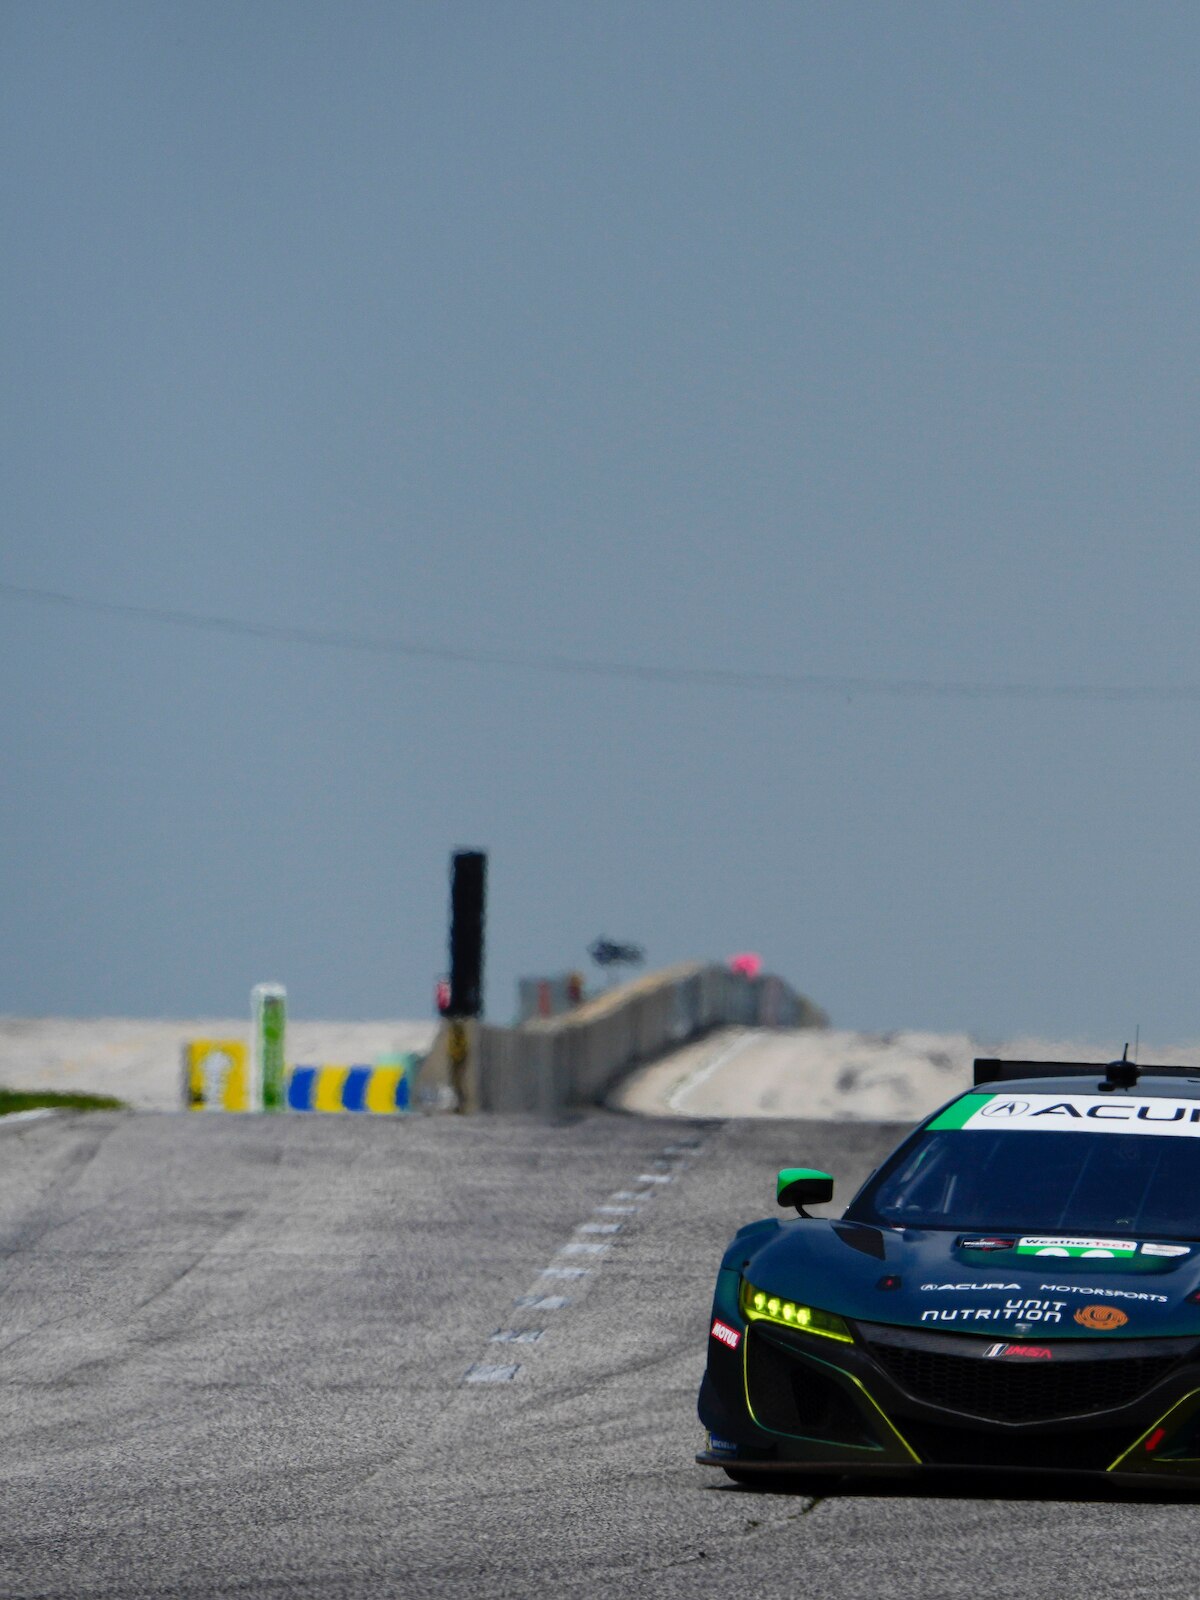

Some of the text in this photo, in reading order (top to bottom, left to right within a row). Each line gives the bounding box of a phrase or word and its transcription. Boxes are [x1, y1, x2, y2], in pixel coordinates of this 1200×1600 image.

[1025, 1238, 1132, 1249] WeatherTech
[937, 1283, 1022, 1291] ACURA
[1039, 1284, 1168, 1303] MOTORSPORTS
[711, 1322, 738, 1348] MOTUL
